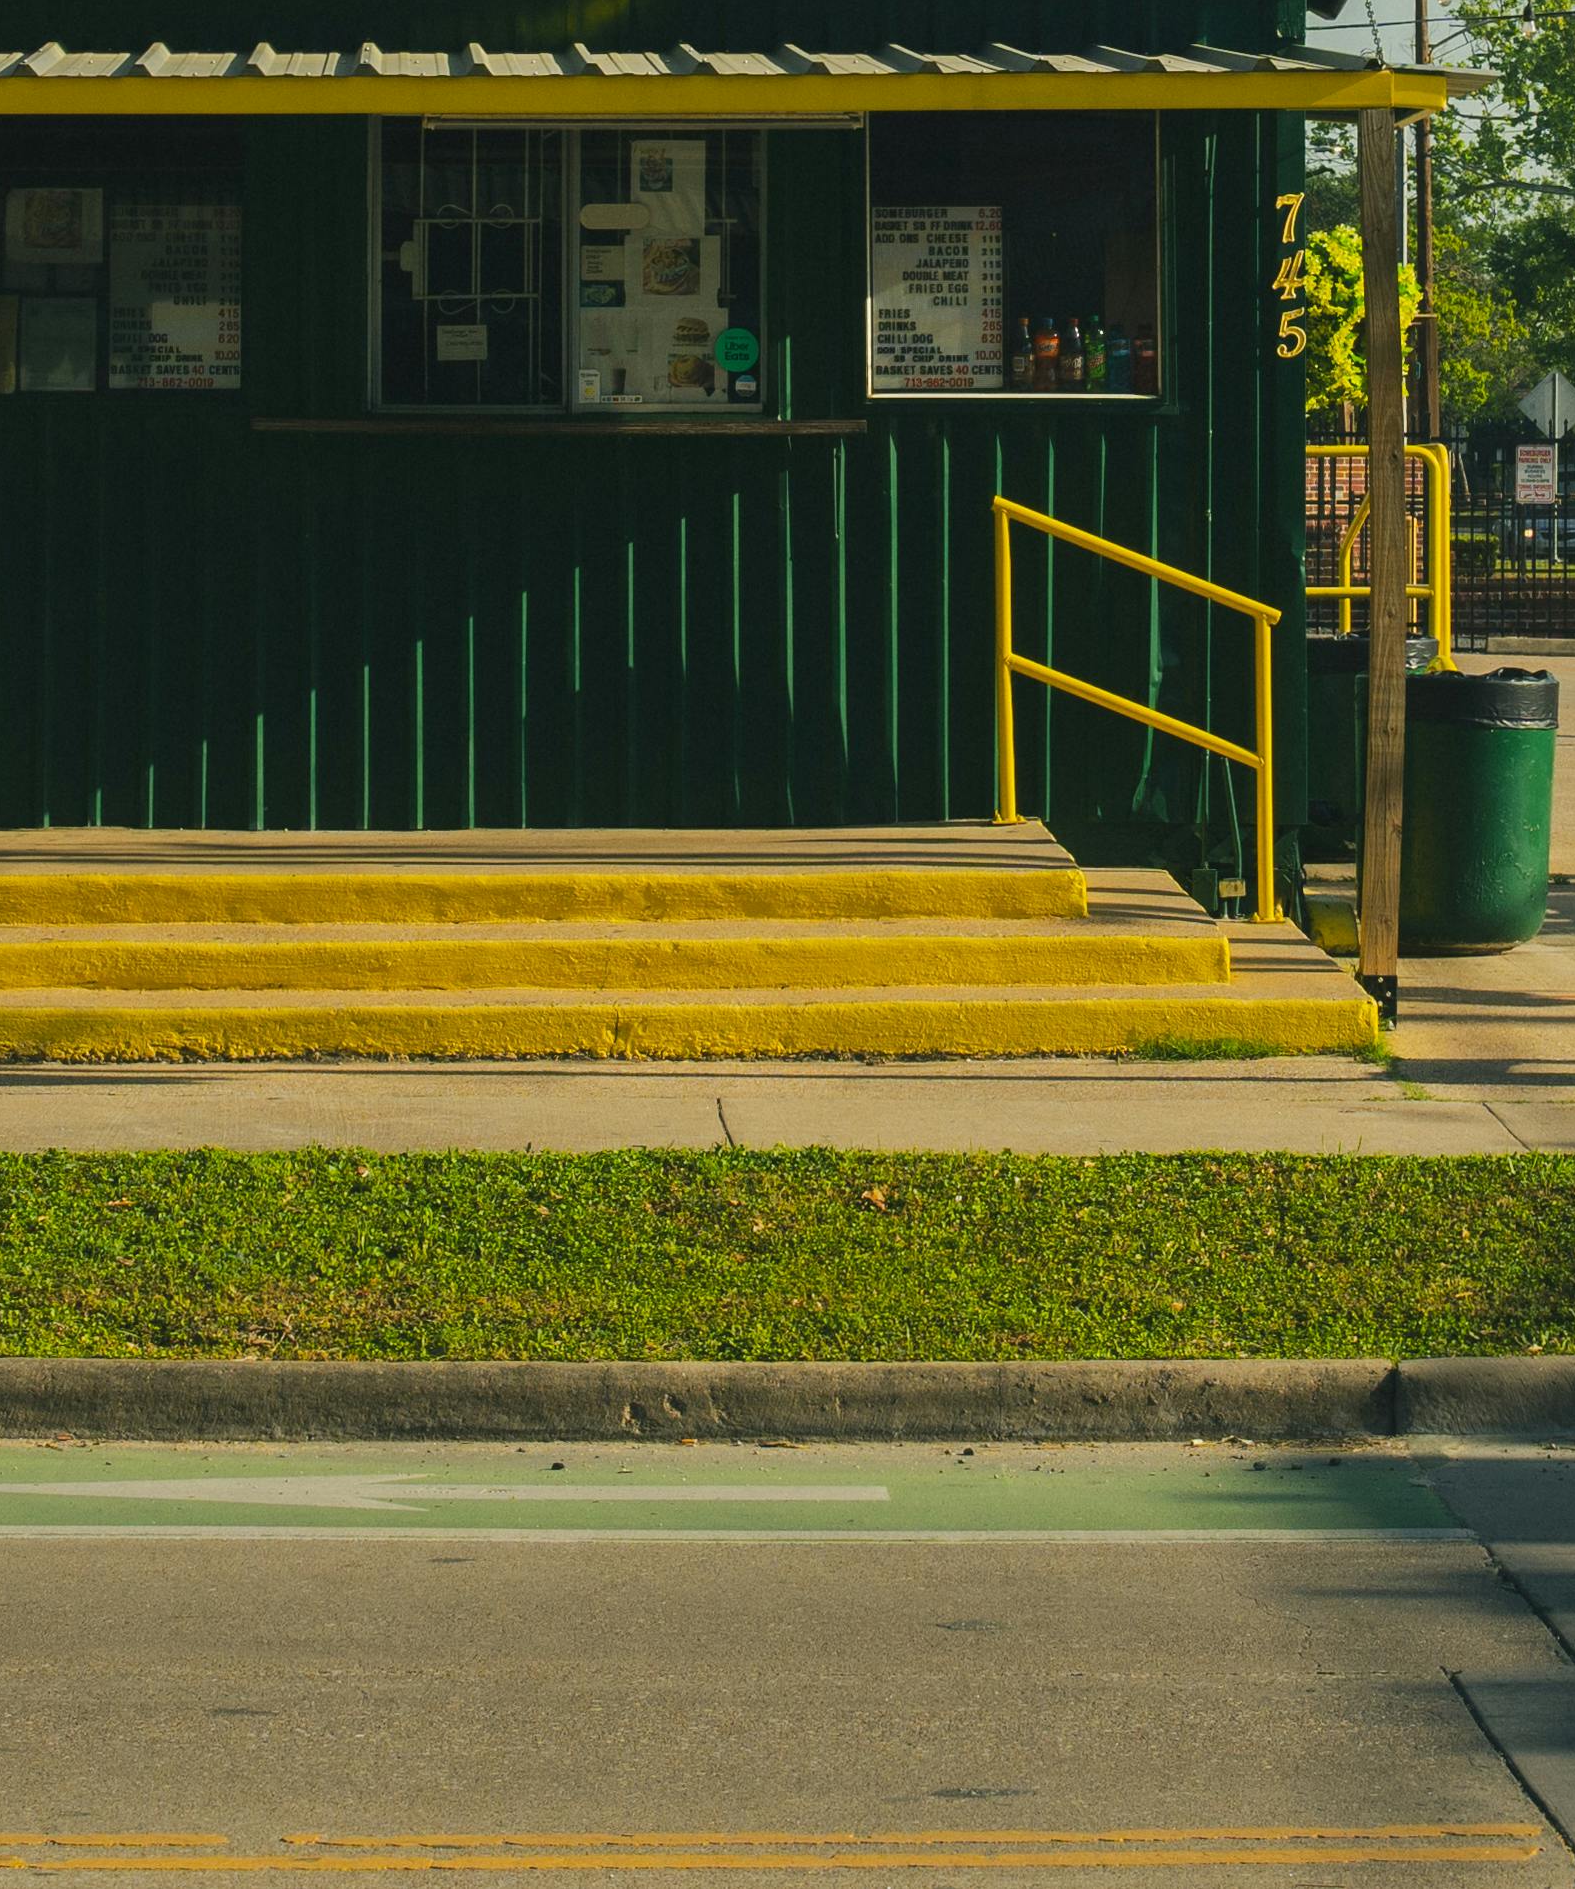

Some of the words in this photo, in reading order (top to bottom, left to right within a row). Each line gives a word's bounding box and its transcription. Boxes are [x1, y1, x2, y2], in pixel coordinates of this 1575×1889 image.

[874, 208, 948, 219] SOMEBURGER
[874, 221, 908, 231] BASKET
[913, 221, 926, 231] SB
[930, 221, 942, 231] FF
[943, 221, 974, 231] DRINK
[874, 233, 895, 244] ADD
[899, 233, 919, 244] ONS
[926, 233, 969, 244] CHEESE
[928, 246, 969, 256] BACON
[915, 258, 969, 269] JALAPENO
[902, 271, 939, 281] DOUBLE
[943, 271, 969, 281] MEAT
[1272, 192, 1307, 358] 745
[908, 283, 943, 294] FRIED
[947, 283, 969, 294] EGG
[933, 296, 968, 306] CHILI
[218, 308, 240, 319] 415
[878, 308, 911, 319] FRIES
[981, 308, 1002, 319] 415
[878, 321, 917, 331] DRINKS
[877, 334, 908, 344] CHILI
[912, 334, 934, 344] DOG
[724, 341, 750, 351] Uber
[900, 346, 943, 354] SPECIAL
[215, 350, 240, 361] 10.00
[724, 351, 750, 361] Eats
[975, 350, 1002, 361] 10.00
[110, 365, 152, 375] BASKET
[156, 365, 190, 375] SAVES
[191, 365, 205, 375] 40
[209, 365, 241, 375] CENTS
[875, 365, 915, 375] BASKET
[919, 365, 954, 375] SAVES
[955, 365, 969, 375] 40
[971, 365, 1003, 375] CENTS
